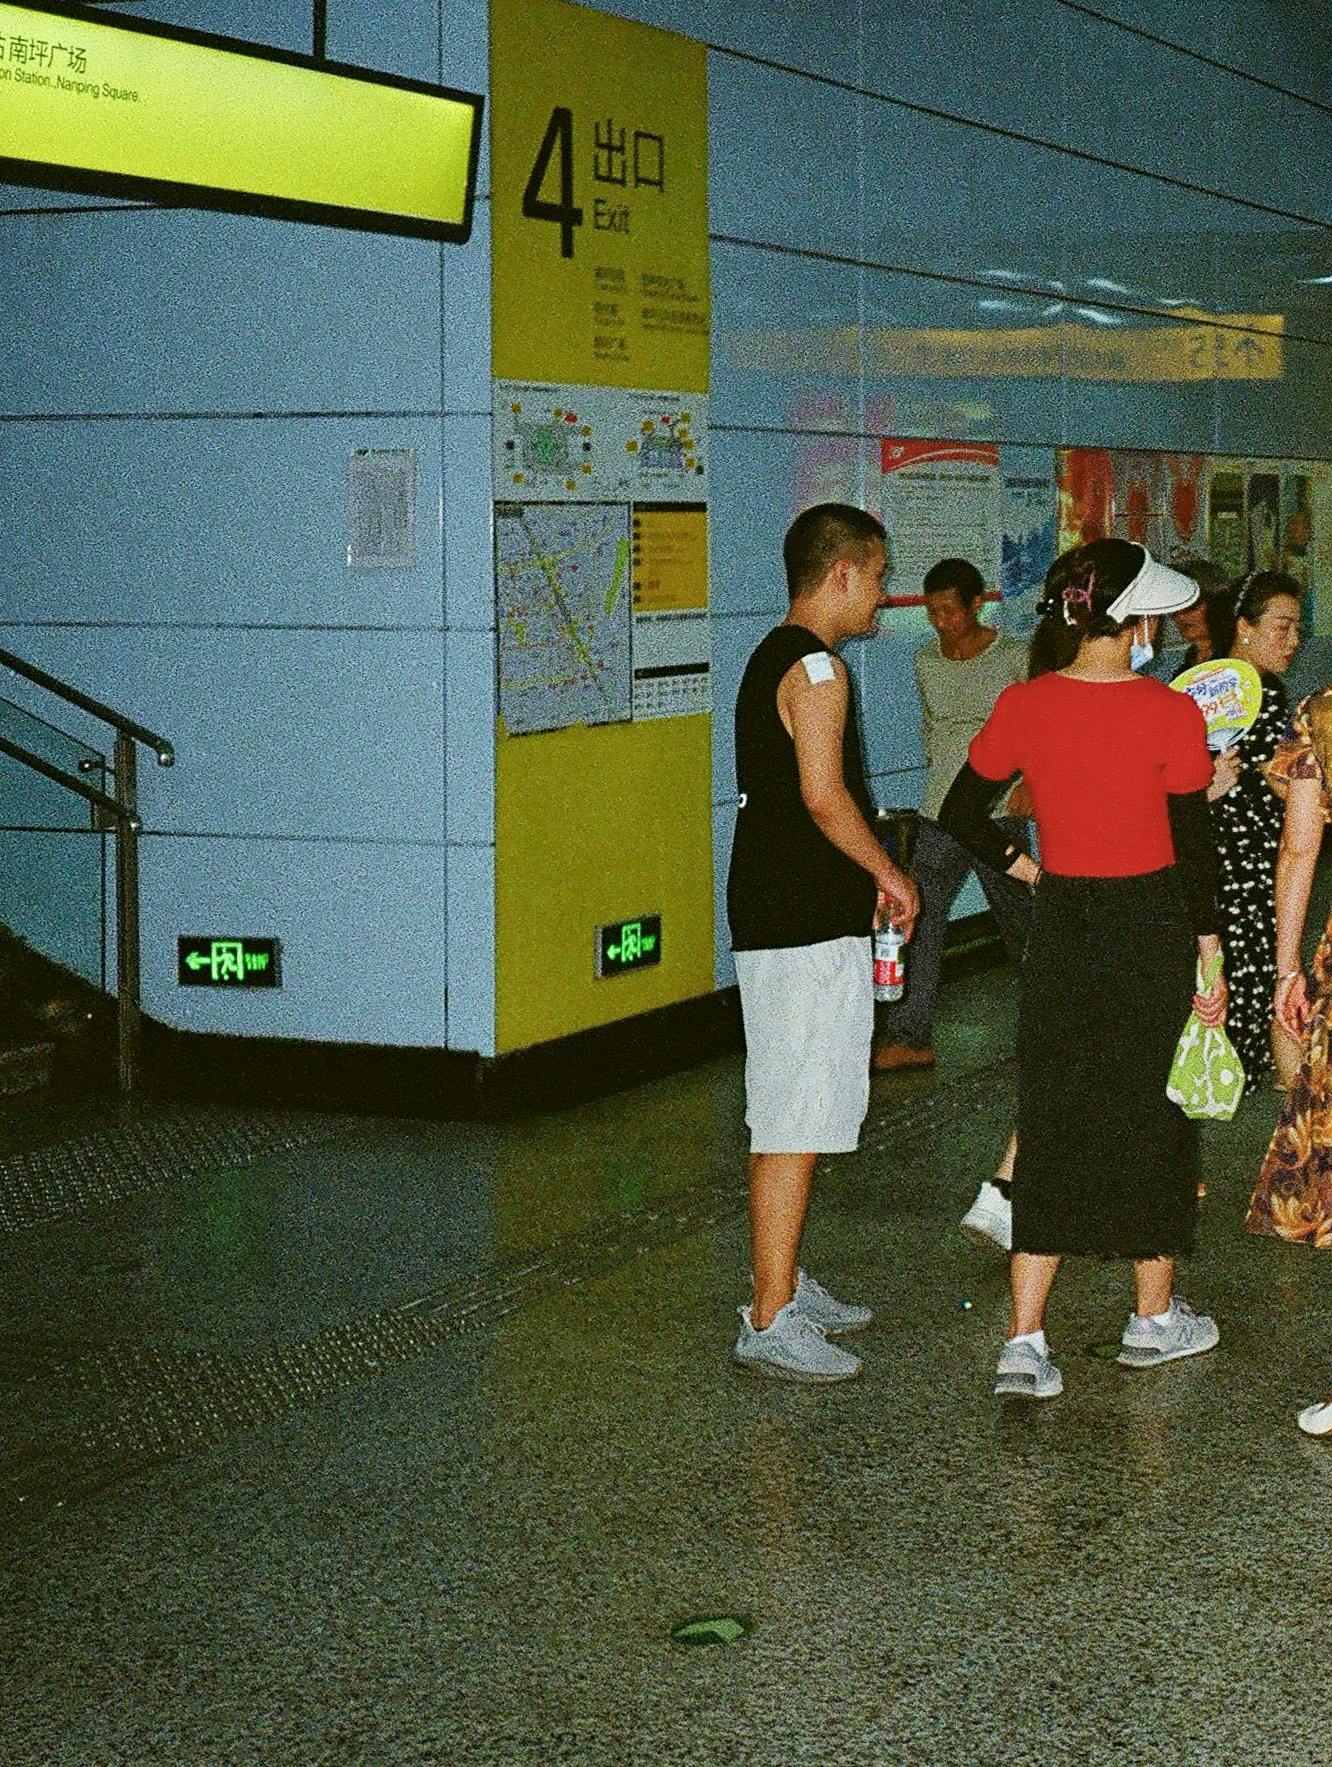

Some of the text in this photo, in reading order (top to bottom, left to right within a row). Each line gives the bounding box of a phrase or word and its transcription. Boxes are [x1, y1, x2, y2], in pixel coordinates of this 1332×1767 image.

[522, 106, 583, 258] 4
[594, 117, 664, 193] 出口
[593, 197, 630, 234] Exit
